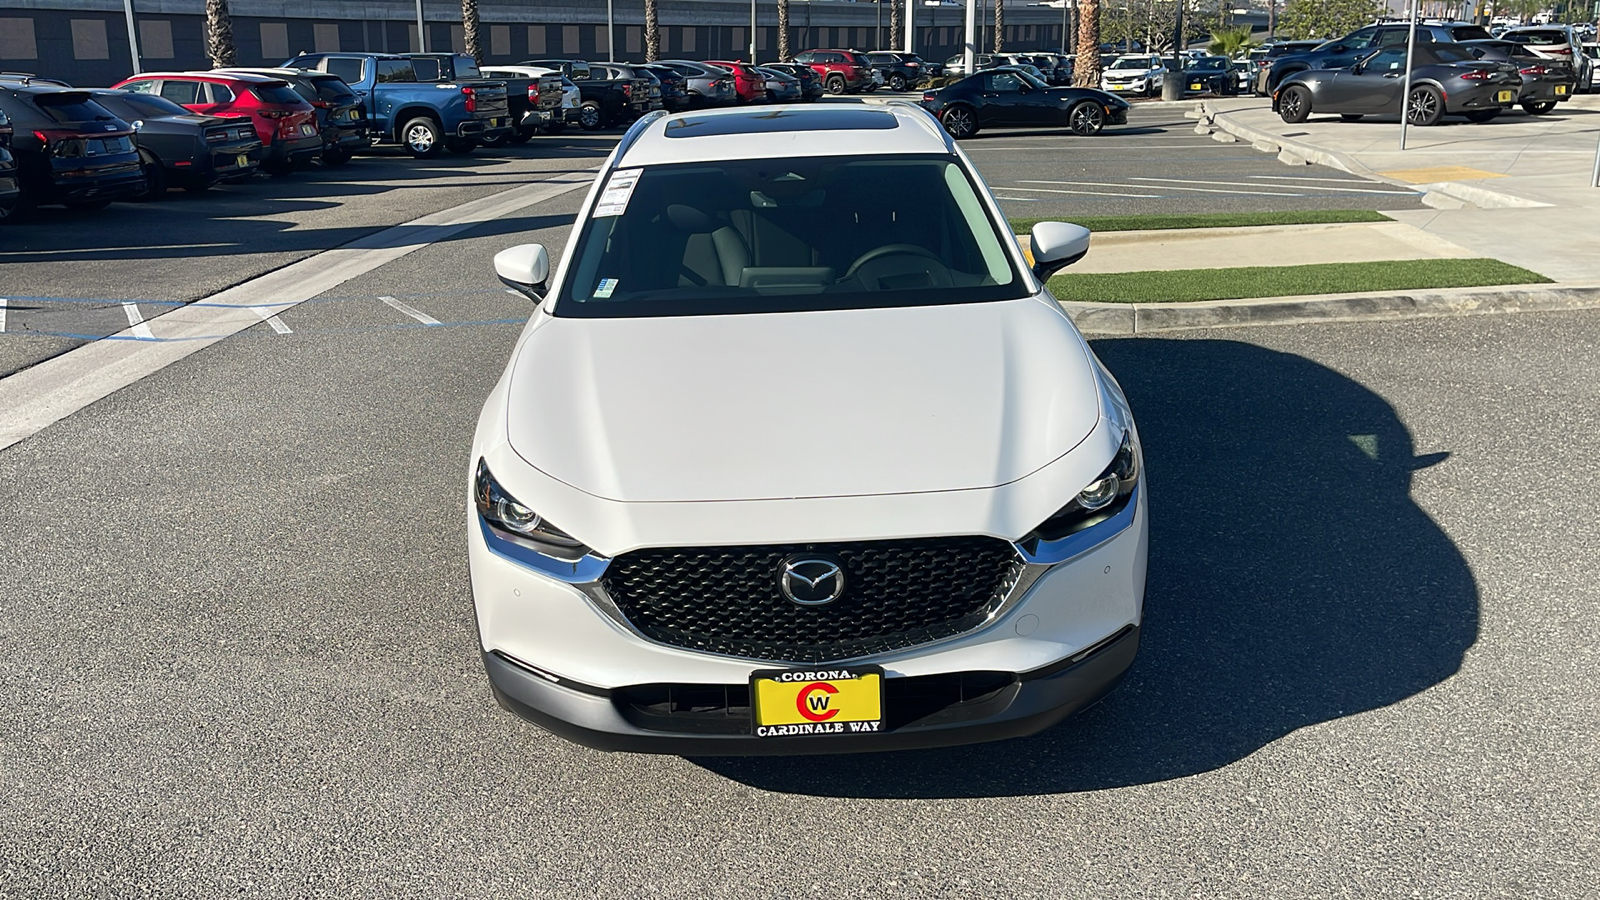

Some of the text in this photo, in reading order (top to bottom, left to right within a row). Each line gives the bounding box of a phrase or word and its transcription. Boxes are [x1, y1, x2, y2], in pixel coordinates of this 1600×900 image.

[781, 670, 850, 682] CORONA
[757, 721, 880, 737] CARDINALE WAY
